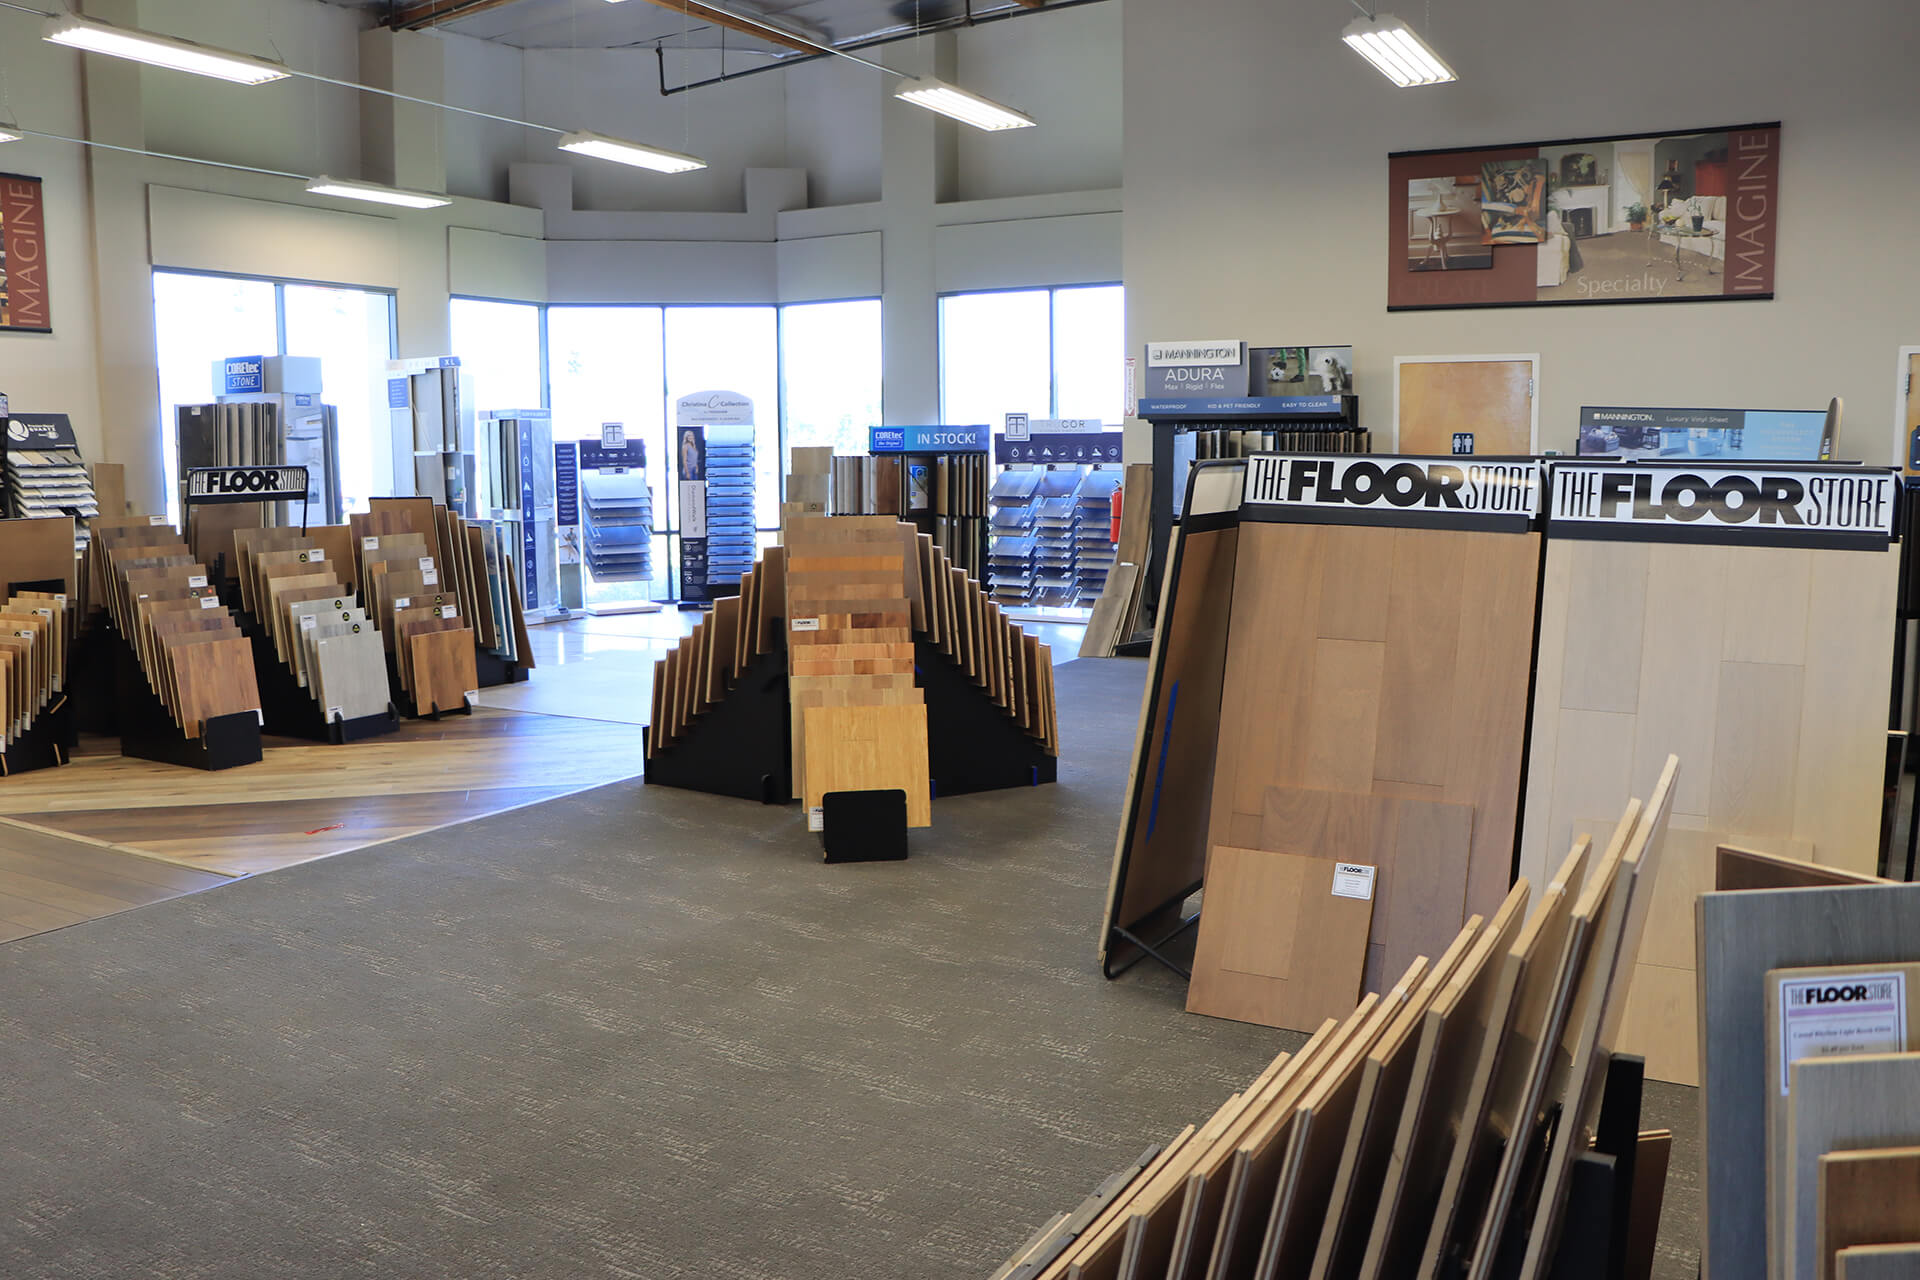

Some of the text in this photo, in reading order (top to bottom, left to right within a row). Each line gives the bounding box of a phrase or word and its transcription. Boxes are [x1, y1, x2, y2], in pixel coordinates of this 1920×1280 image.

[1734, 133, 1768, 291] IMAGINE
[8, 183, 43, 324] IMAGINE
[1577, 272, 1668, 296] Specialty
[1165, 348, 1235, 360] MANNINGTON
[232, 376, 256, 387] STONE
[1165, 368, 1224, 381] ADURA
[1185, 383, 1204, 391] Rigid
[1601, 413, 1654, 422] MANNINGTON
[1666, 415, 1688, 423] Luxury
[1691, 415, 1708, 423] Vinyl
[917, 433, 930, 444] IN
[933, 432, 976, 445] STOCK!
[190, 468, 306, 494] THE FLOOR STORE
[1253, 458, 1536, 512] THE FLOOR STORE
[1559, 471, 1889, 528] THE FLOOR STORE
[1805, 985, 1867, 1004] FLOOR
[1867, 982, 1893, 1001] STORE
